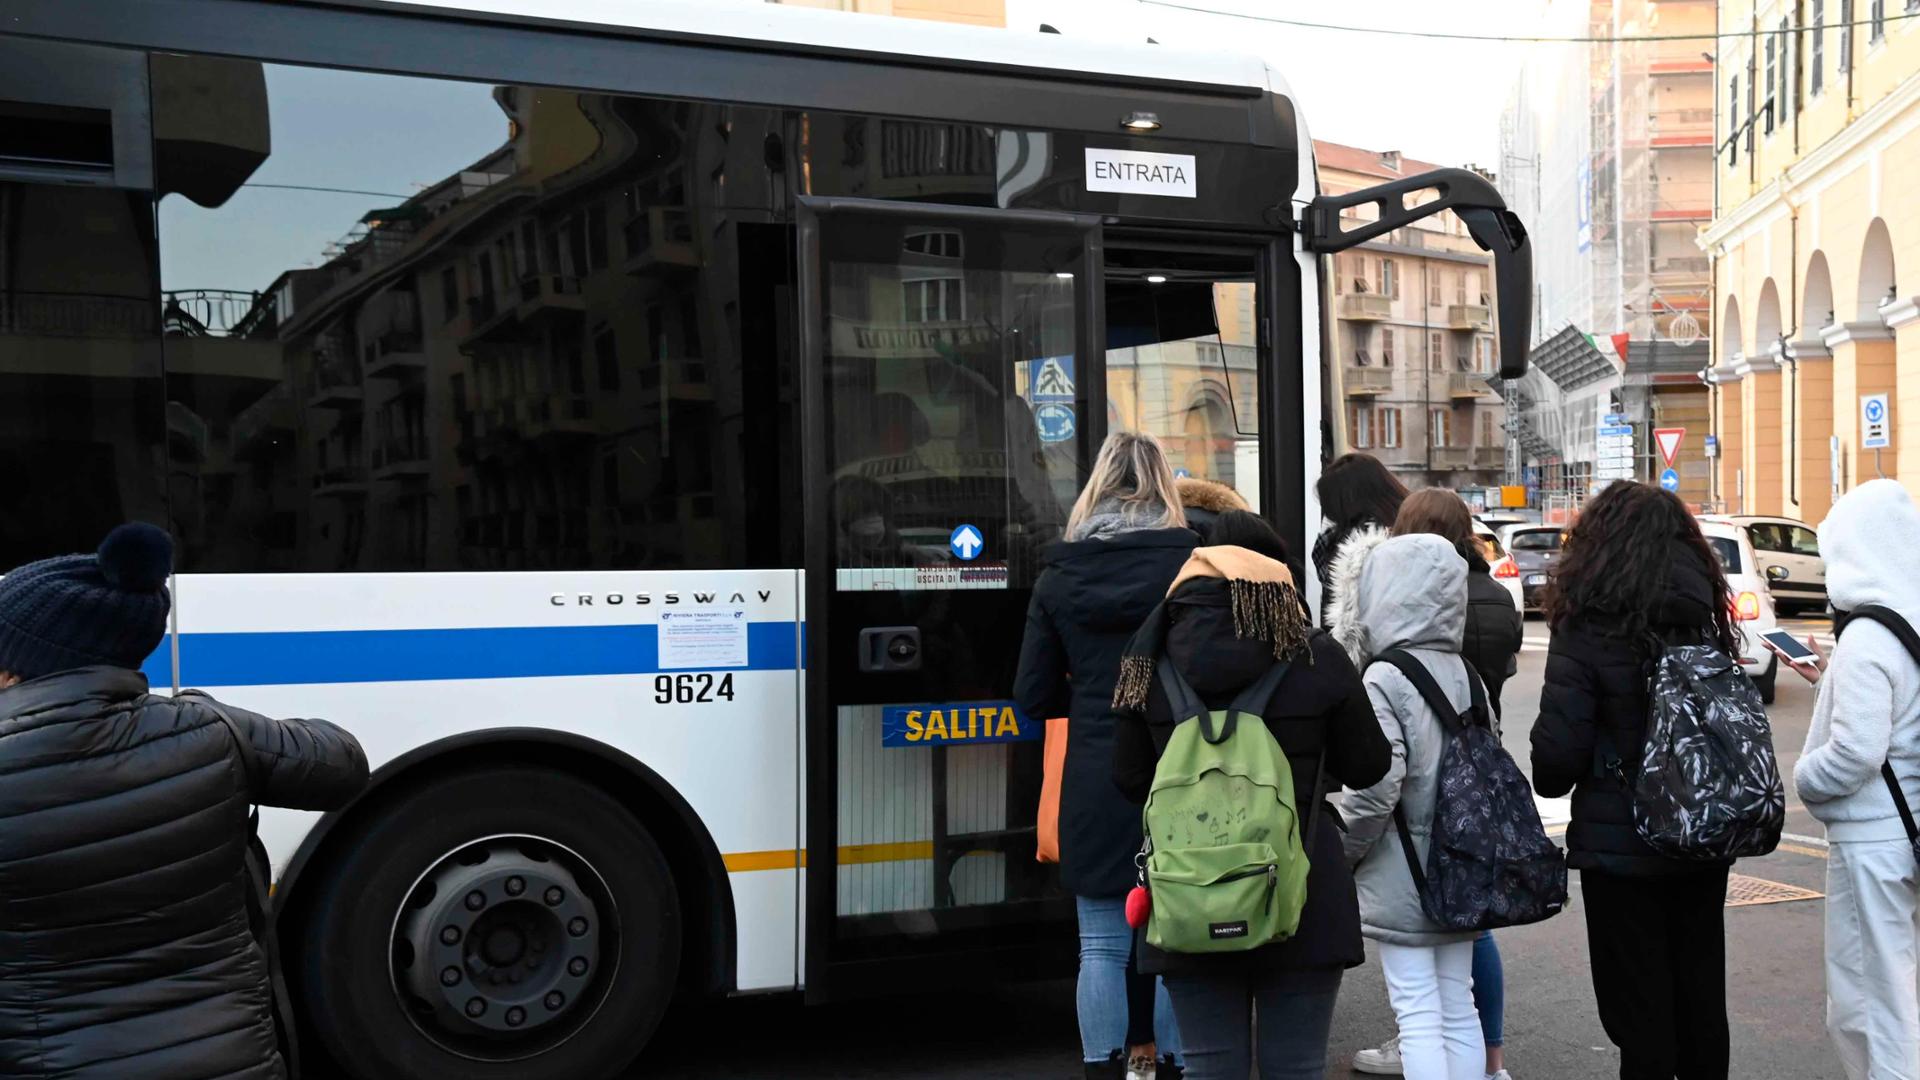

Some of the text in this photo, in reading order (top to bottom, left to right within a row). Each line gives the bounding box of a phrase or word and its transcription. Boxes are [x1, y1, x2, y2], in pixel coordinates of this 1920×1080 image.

[1095, 161, 1186, 184] ENTRATA
[917, 575, 944, 584] USCITA
[948, 575, 956, 583] DI
[550, 590, 771, 606] CROSSWAY
[655, 673, 734, 704] 9624
[904, 707, 1019, 742] SALITA
